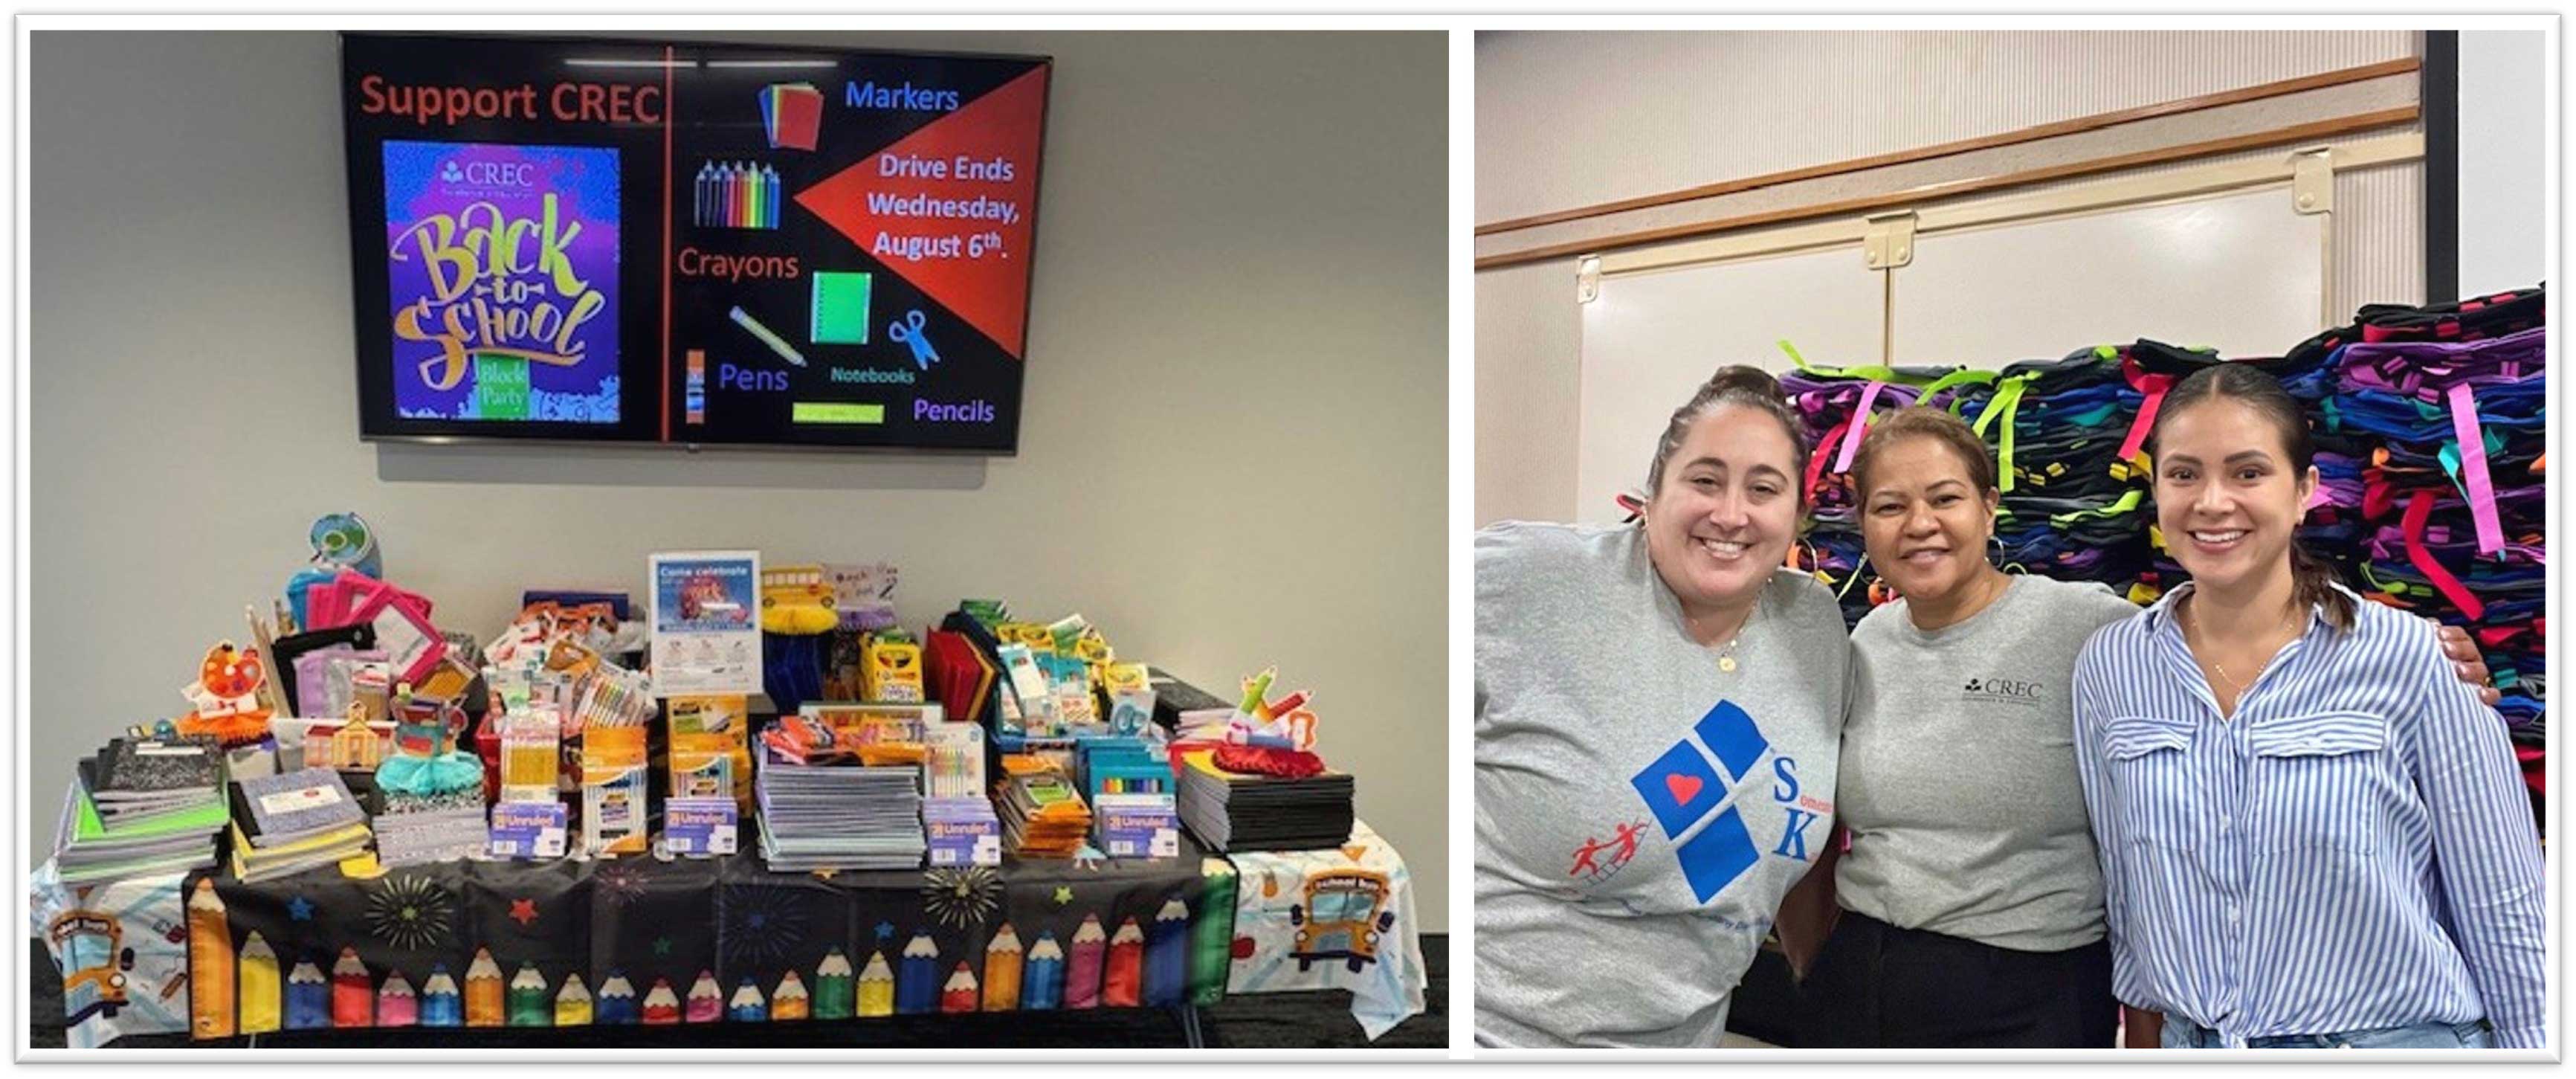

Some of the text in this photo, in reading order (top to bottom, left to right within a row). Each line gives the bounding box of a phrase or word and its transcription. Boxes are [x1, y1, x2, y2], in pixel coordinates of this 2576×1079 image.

[361, 74, 660, 125] Support CREC
[845, 81, 959, 112] Markers
[465, 161, 534, 187] CREC
[879, 153, 1014, 181] Drive Ends
[867, 192, 1019, 224] Wednesday,
[873, 231, 961, 260] August
[678, 247, 800, 282] Crayons
[481, 361, 524, 383] Block
[720, 363, 789, 391] Pens
[830, 367, 915, 384] Notebooks
[482, 386, 523, 410] Party
[914, 399, 995, 424] Pencils
[1986, 677, 2043, 699] CREC
[1774, 756, 1799, 802] S
[1772, 807, 1818, 862] K
